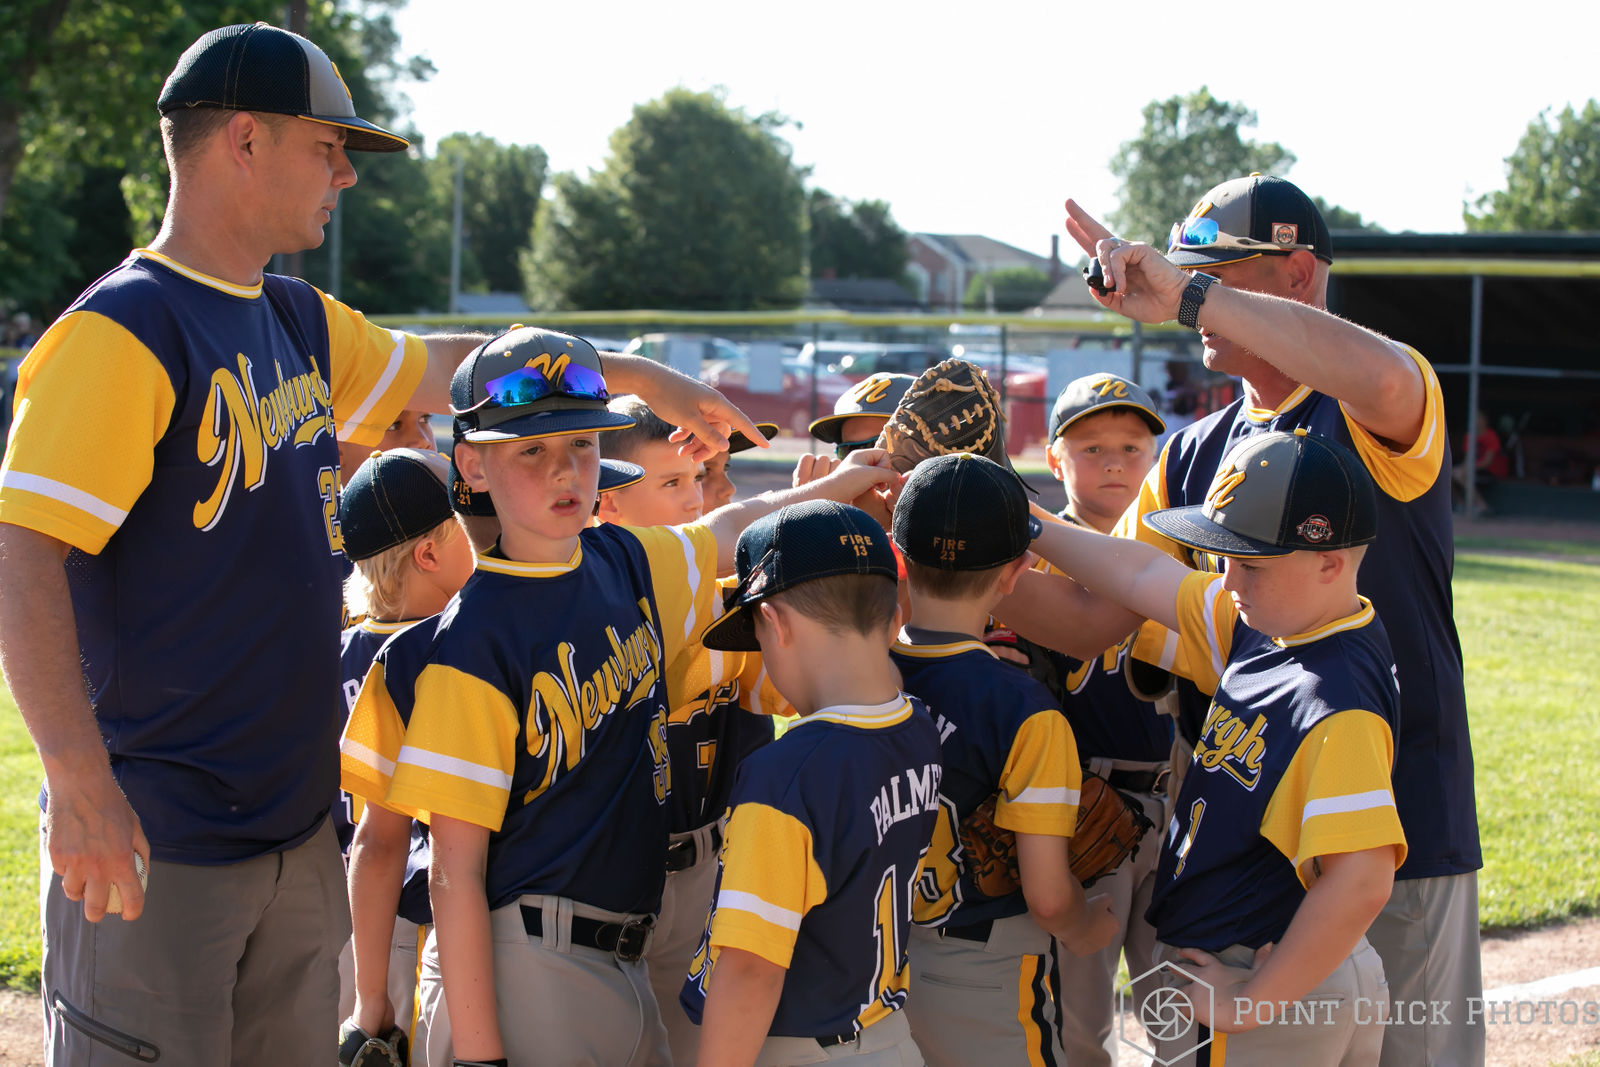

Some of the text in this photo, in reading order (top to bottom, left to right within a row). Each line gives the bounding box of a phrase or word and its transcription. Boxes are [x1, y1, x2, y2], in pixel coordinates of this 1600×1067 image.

[839, 534, 874, 546] FIRE
[933, 536, 967, 550] FIRE
[853, 544, 868, 557] 13
[940, 550, 956, 561] 23
